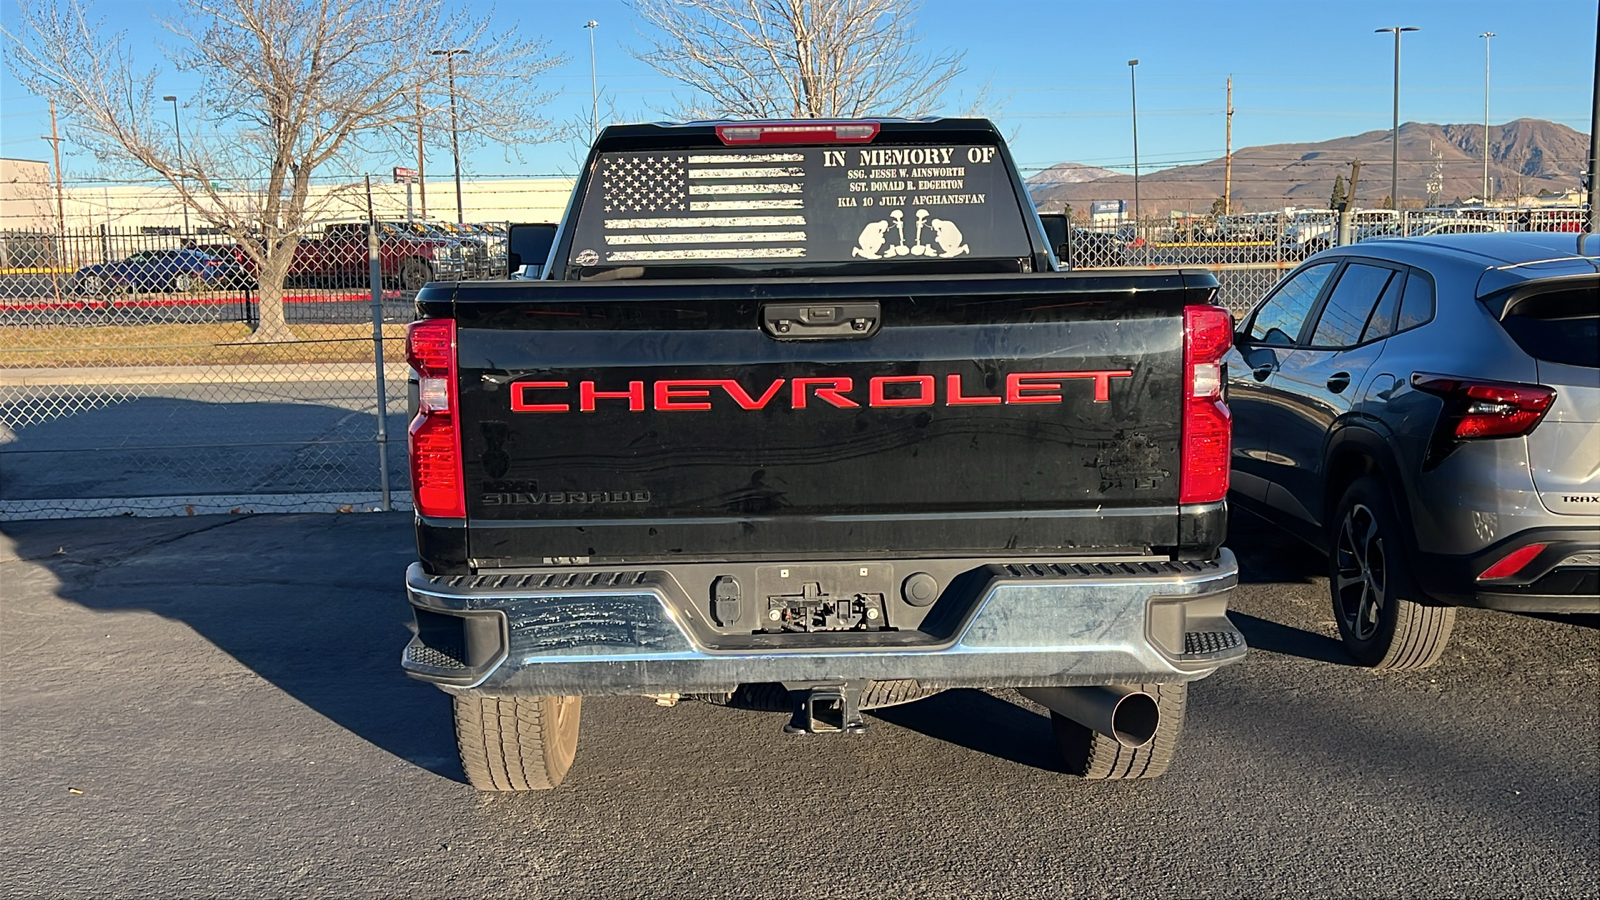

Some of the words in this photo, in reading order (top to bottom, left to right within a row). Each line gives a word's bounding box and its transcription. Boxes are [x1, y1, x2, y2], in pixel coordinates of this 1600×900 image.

[823, 151, 846, 167] IN
[860, 148, 954, 167] MEMORY
[967, 147, 995, 164] OF
[847, 169, 868, 180] SSG.
[869, 168, 897, 179] JESSE
[899, 168, 909, 178] W.
[911, 167, 965, 178] AINSWORTH
[849, 182, 869, 192] SGT.
[870, 181, 905, 192] DONALD
[906, 181, 917, 191] R.
[918, 179, 964, 190] EDGERTON
[837, 197, 857, 207] KIA
[862, 196, 874, 207] 10
[879, 196, 907, 206] JULY
[912, 194, 986, 205] AFGHANISTAN
[510, 369, 1133, 413] CHEVROLET
[482, 490, 651, 506] SILVERADO
[1561, 495, 1600, 503] TRAX
